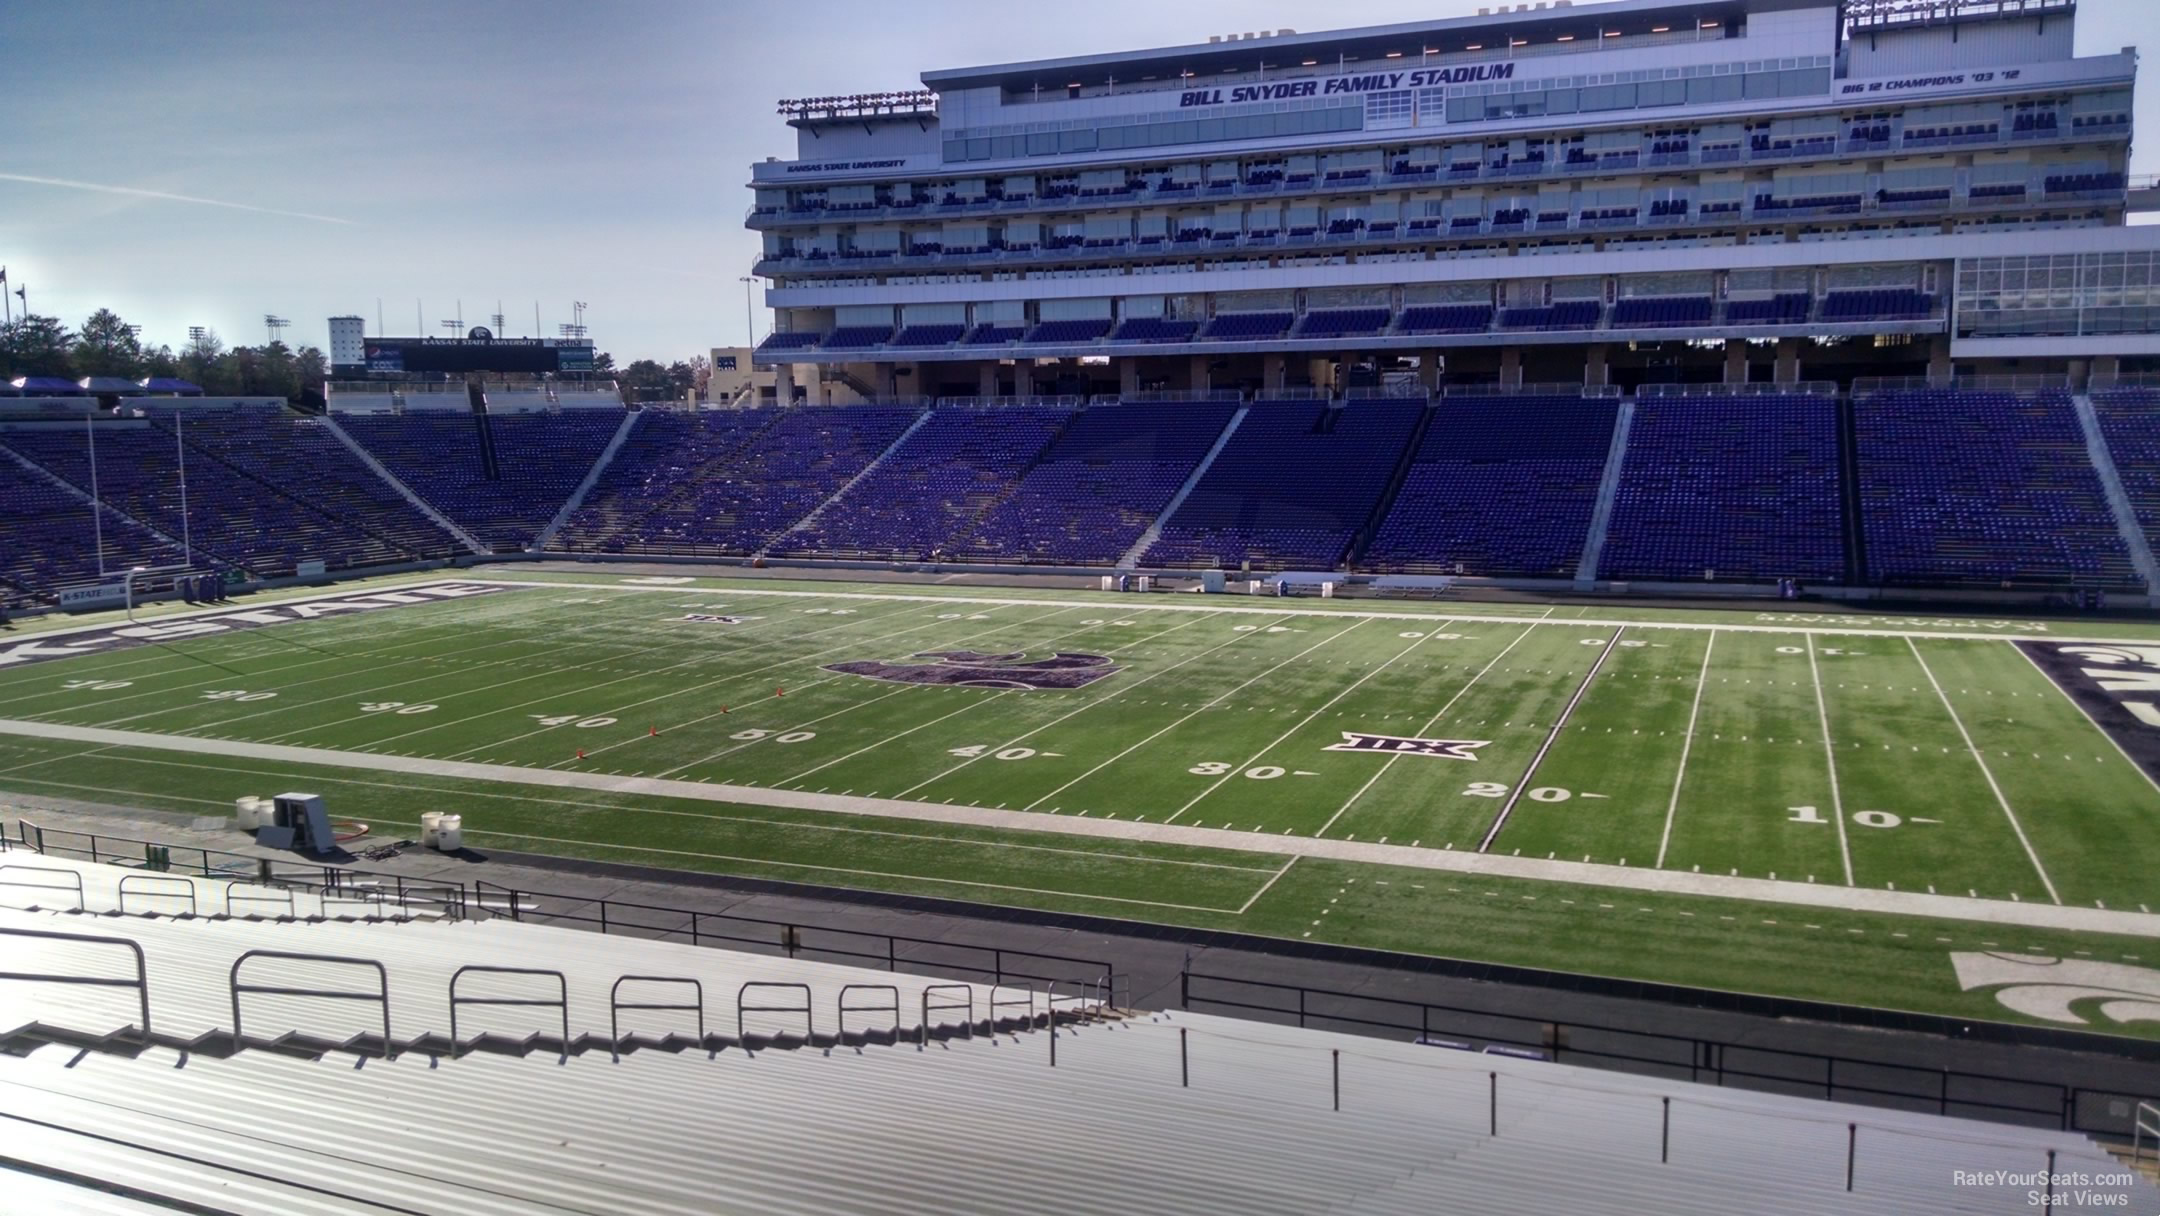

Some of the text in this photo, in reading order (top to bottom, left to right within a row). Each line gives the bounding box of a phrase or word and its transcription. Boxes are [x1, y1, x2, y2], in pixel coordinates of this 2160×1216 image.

[1180, 63, 1514, 107] BILL SNYDER FAMILY STADIUM
[1842, 70, 2020, 94] BIG 12 CHAMPIONS '03 '12
[787, 160, 905, 173] KANSAS STATE UNIVERSITY
[554, 339, 582, 347] aetna
[729, 728, 816, 744] 50
[947, 744, 1036, 760] 40
[1188, 762, 1286, 779] 30
[1462, 782, 1571, 802] 20
[1787, 806, 1902, 828] 10
